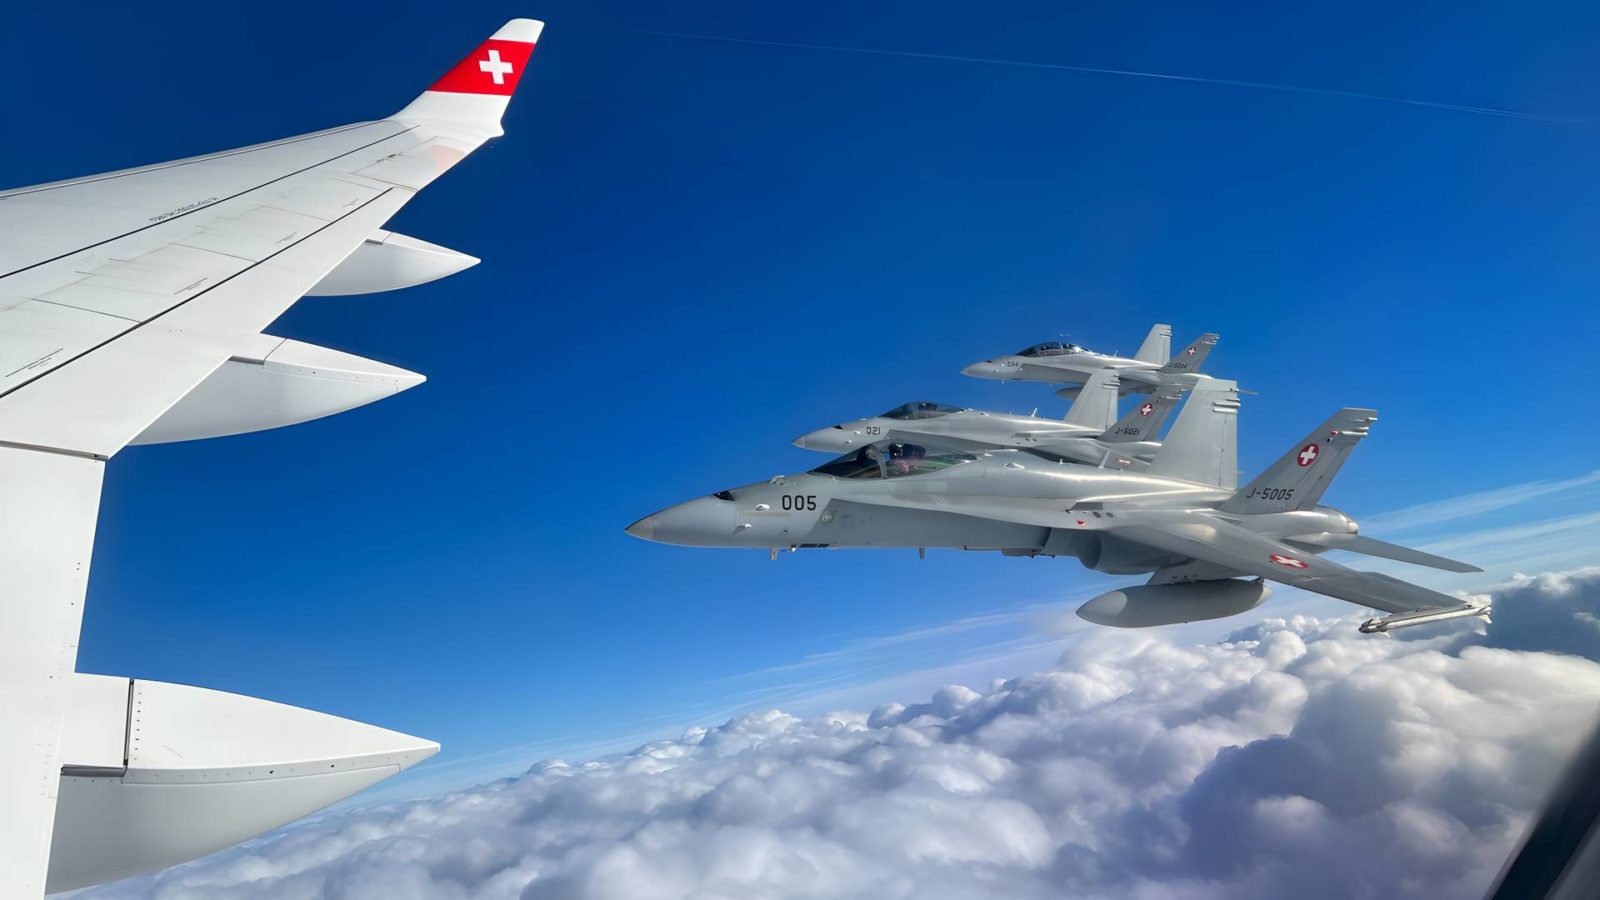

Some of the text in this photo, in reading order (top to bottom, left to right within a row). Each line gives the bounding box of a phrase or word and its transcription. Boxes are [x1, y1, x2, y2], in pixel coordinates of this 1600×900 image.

[866, 426, 881, 435] 021
[1246, 487, 1295, 500] J-5005
[781, 494, 817, 511] 005
